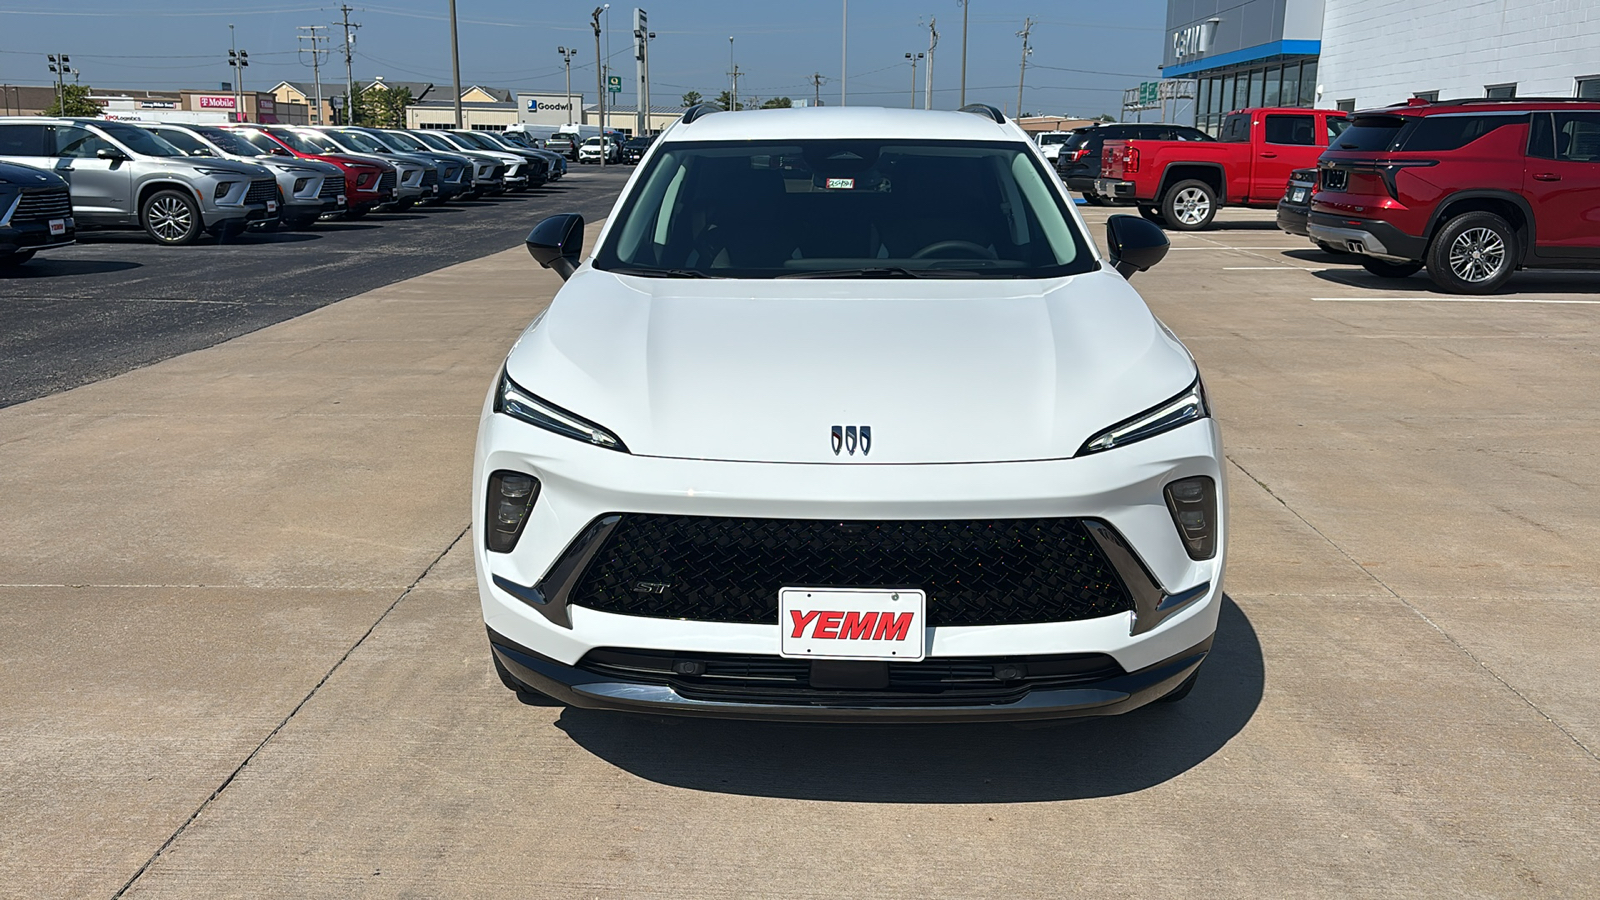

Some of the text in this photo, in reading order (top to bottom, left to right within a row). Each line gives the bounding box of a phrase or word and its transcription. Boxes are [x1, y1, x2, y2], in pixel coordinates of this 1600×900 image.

[208, 98, 234, 107] Mobile
[538, 102, 572, 110] Goodwil
[633, 581, 670, 594] ST
[790, 610, 914, 641] YEMM
